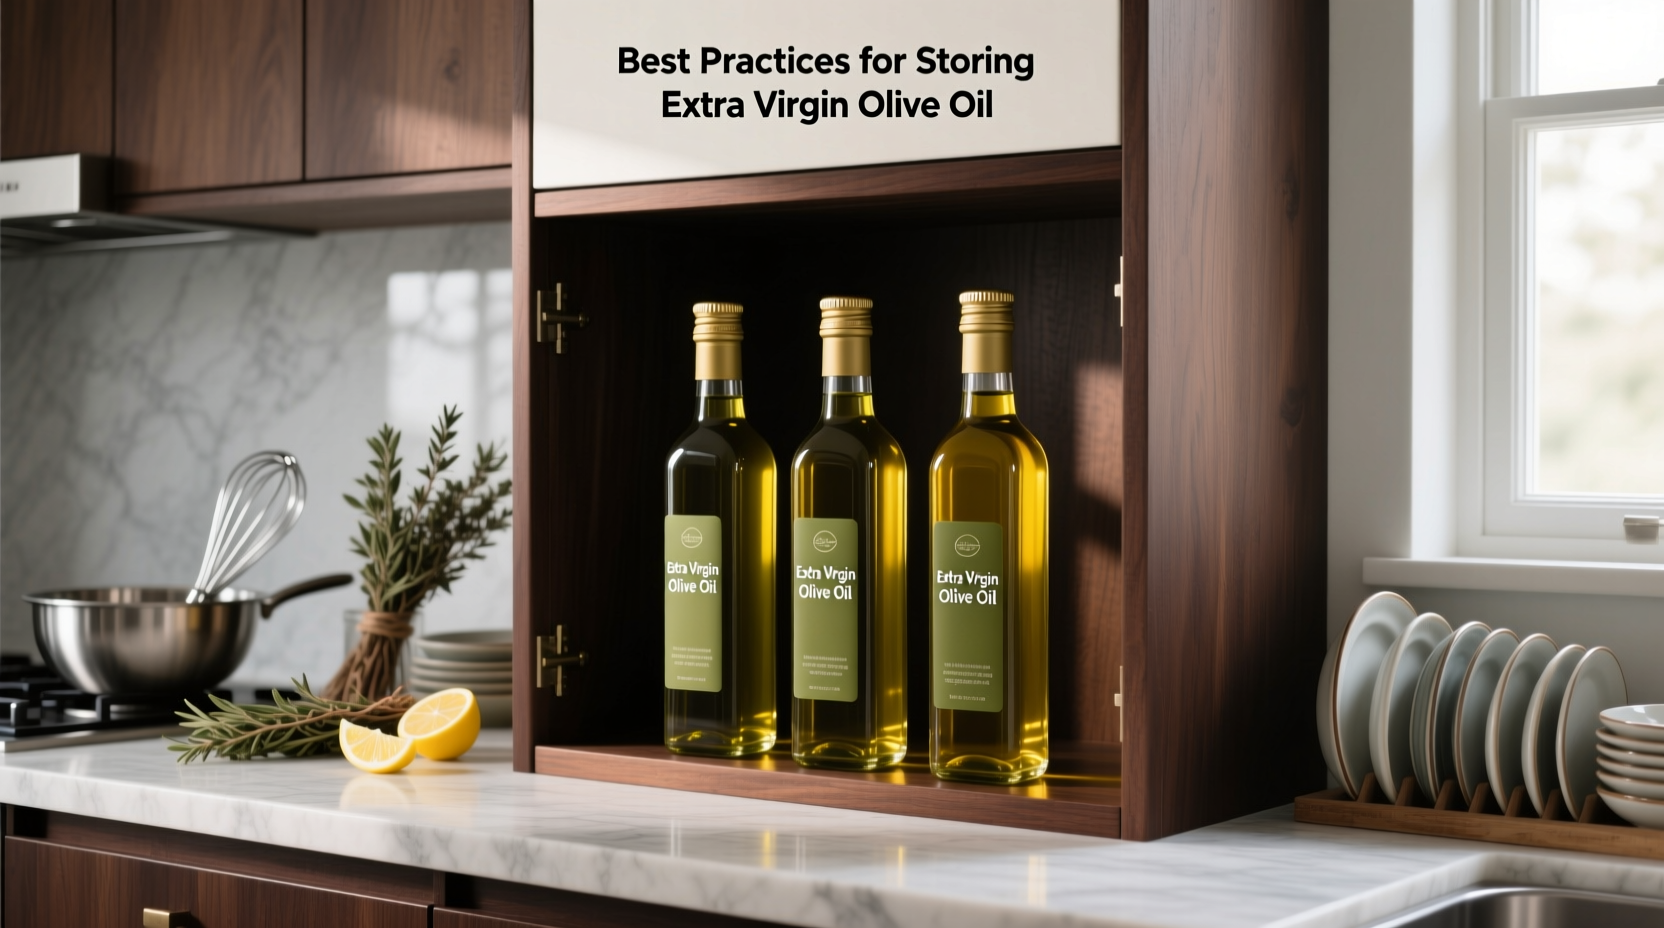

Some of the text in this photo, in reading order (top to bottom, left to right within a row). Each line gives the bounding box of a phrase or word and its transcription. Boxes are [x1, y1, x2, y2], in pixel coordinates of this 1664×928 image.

[668, 578, 717, 594] Olive Oil
[798, 584, 852, 600] Olive Oil
[938, 588, 997, 605] Olive Oil
